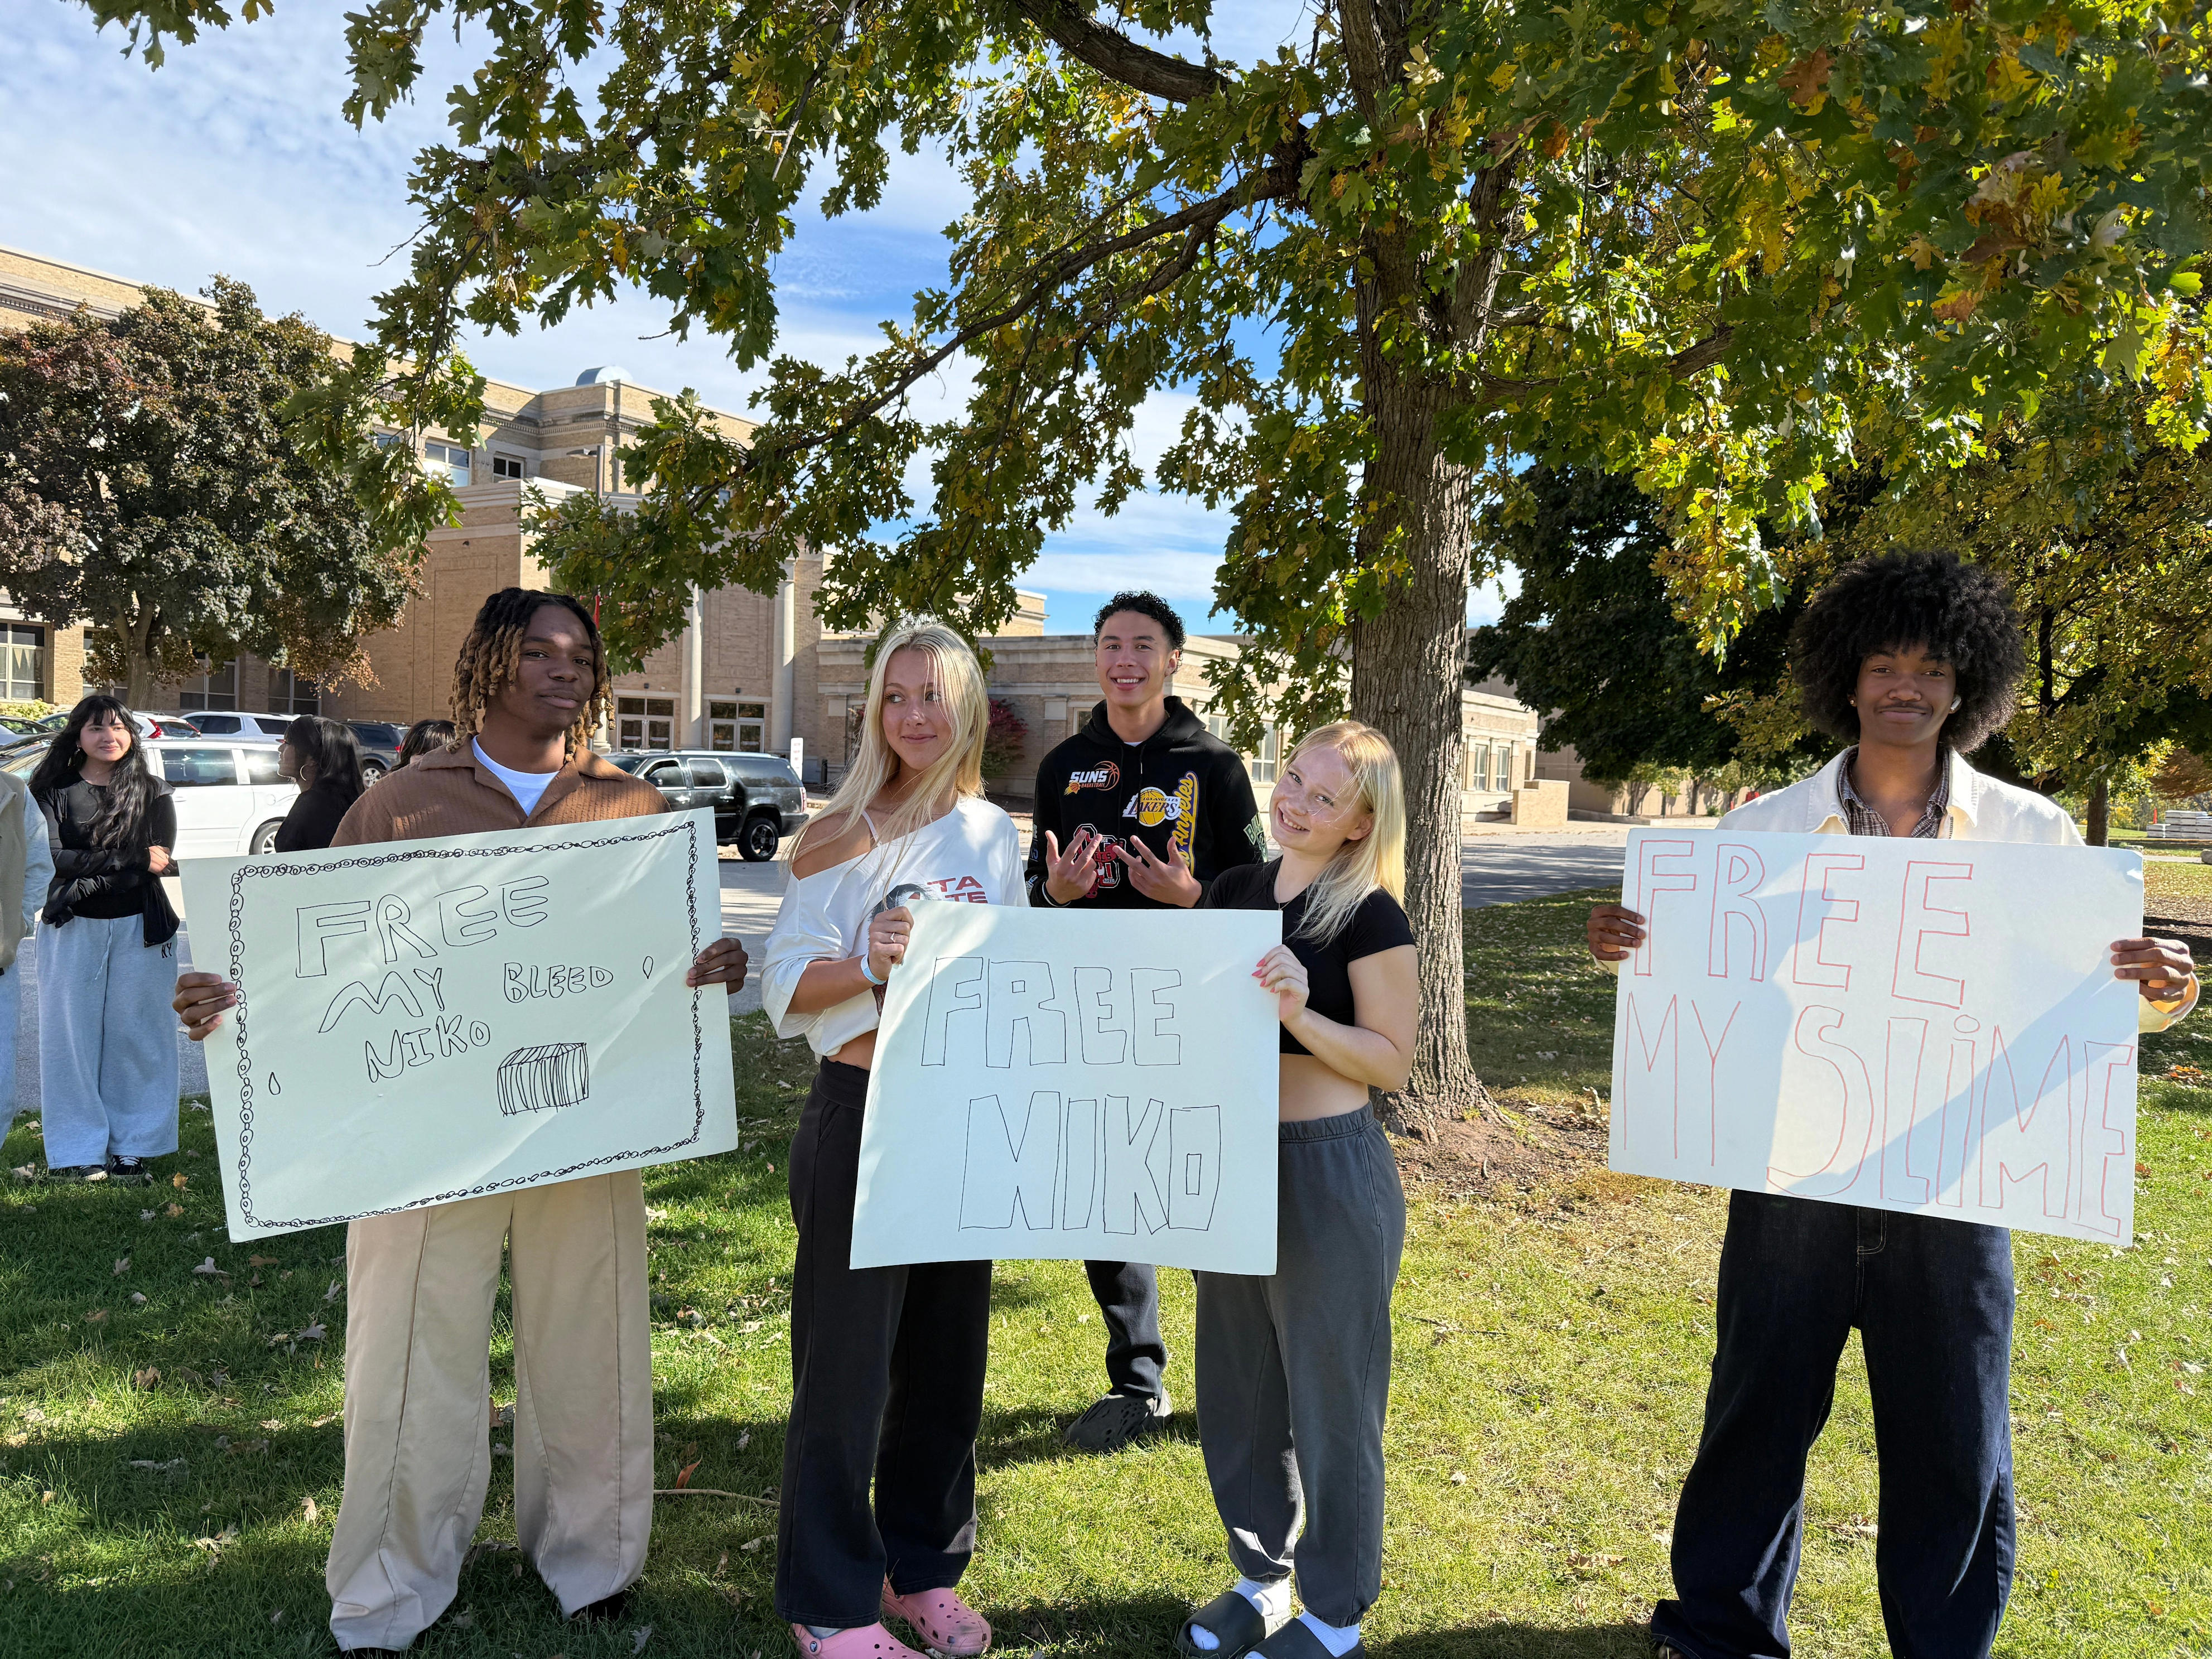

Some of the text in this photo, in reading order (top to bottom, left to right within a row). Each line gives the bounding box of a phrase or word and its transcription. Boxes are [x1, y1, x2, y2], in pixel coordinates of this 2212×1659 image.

[1069, 770, 1109, 783] SUNS
[1127, 798, 1179, 817] LAKERS
[1172, 772, 1196, 847] Angeles
[295, 875, 550, 978] FREE
[1633, 839, 1974, 1009] FREE
[318, 967, 443, 1033] MY
[503, 962, 614, 1003] BLEED
[921, 957, 1182, 1068] FREE
[365, 1014, 491, 1083] NIKO
[1623, 991, 1741, 1167] MY
[958, 1091, 1221, 1236] NIKO
